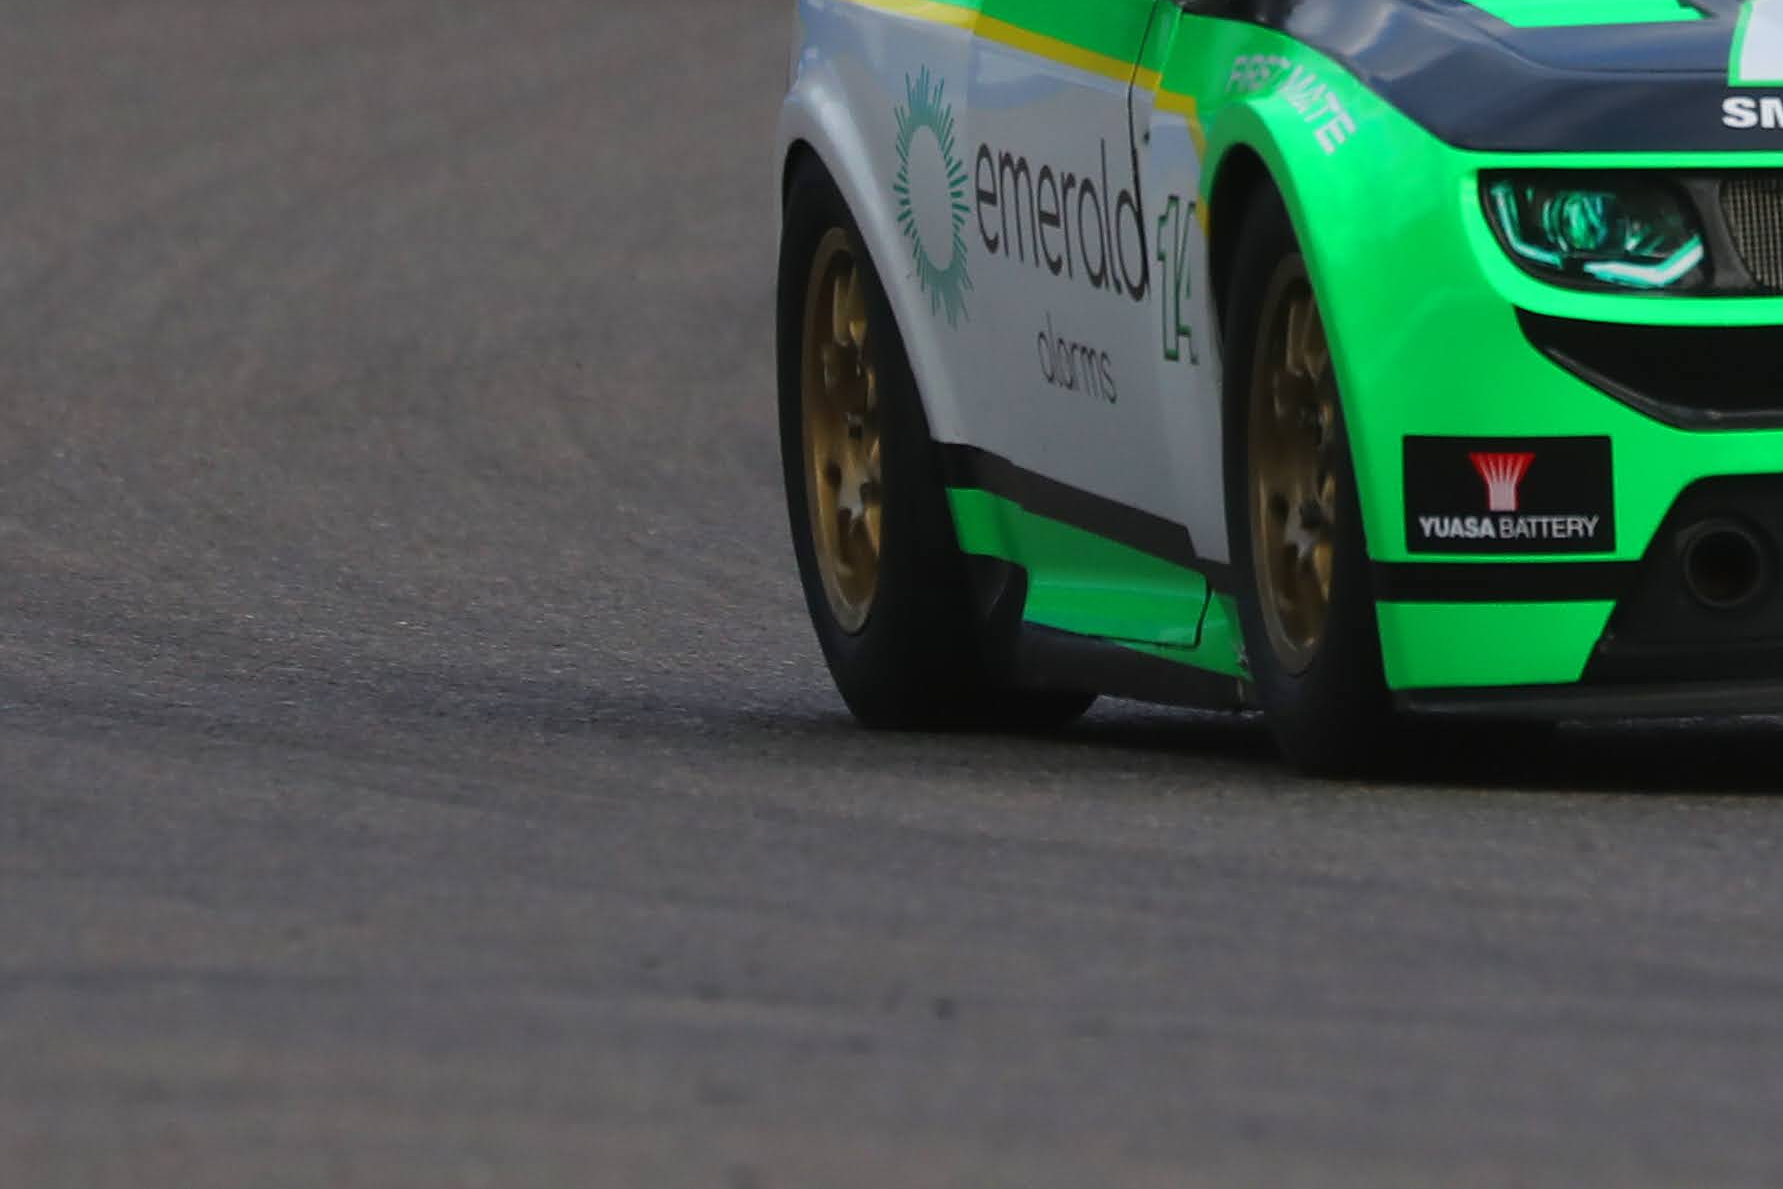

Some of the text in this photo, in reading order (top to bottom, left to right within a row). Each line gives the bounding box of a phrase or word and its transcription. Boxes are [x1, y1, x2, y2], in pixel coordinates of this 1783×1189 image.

[974, 139, 1150, 302] emerald
[1037, 312, 1117, 404] alarms
[1419, 515, 1600, 539] YUASA BATTERY
